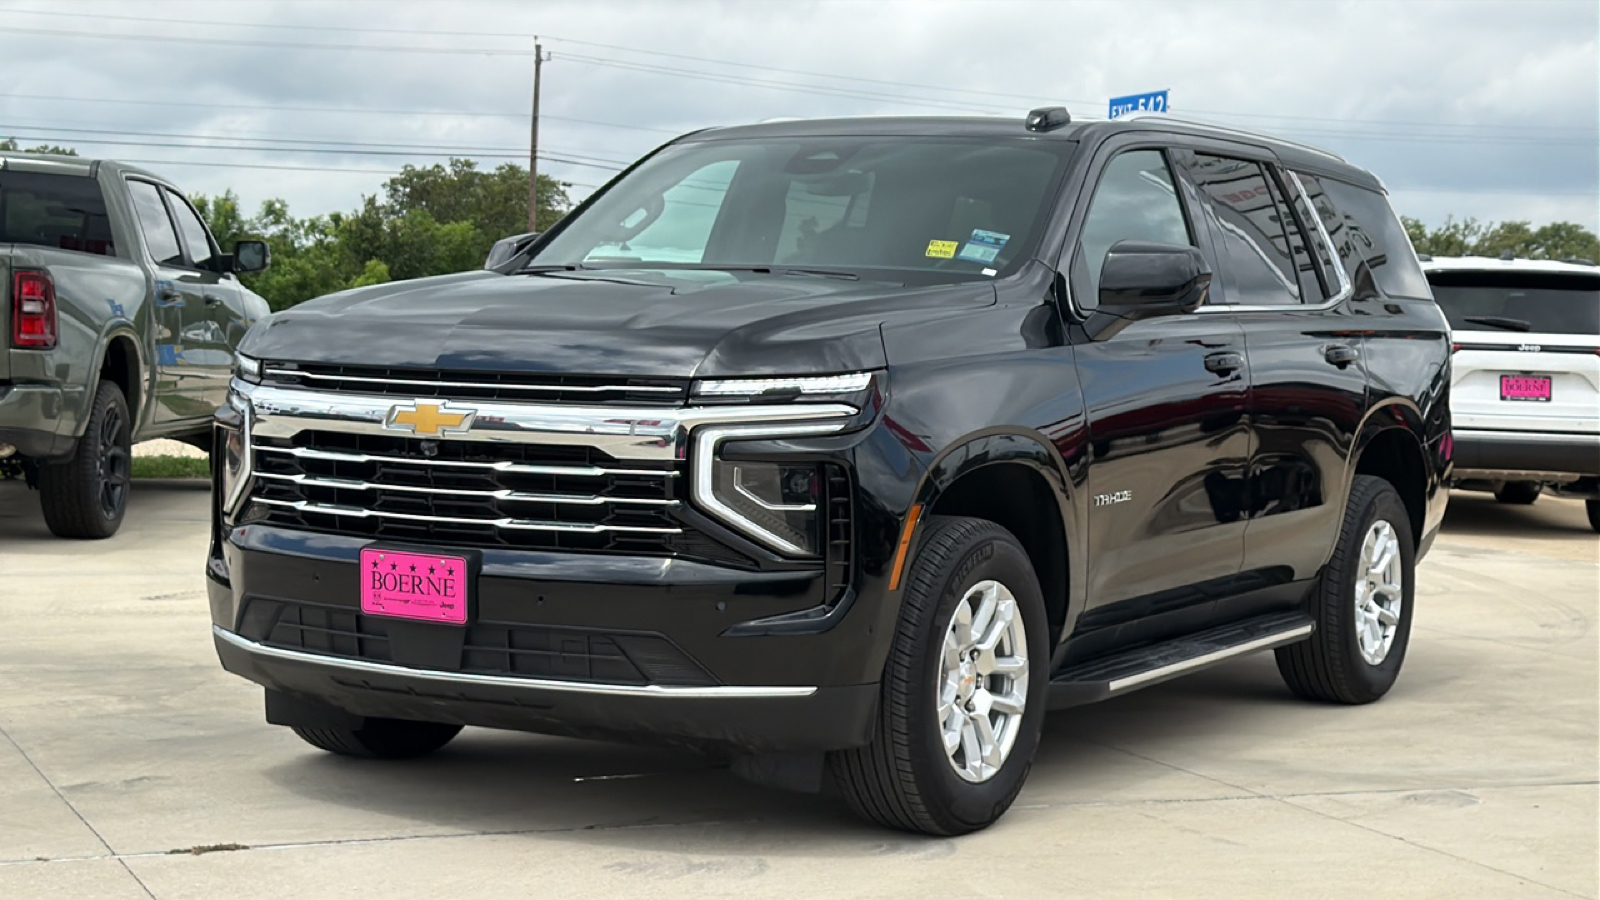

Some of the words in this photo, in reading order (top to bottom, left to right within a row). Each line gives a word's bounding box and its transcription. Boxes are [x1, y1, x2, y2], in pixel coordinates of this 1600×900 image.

[1111, 103, 1133, 118] EXIT
[1138, 95, 1164, 112] 542
[1519, 344, 1541, 352] Jeep
[1093, 490, 1132, 506] TAHOE
[371, 570, 456, 598] BOERNE
